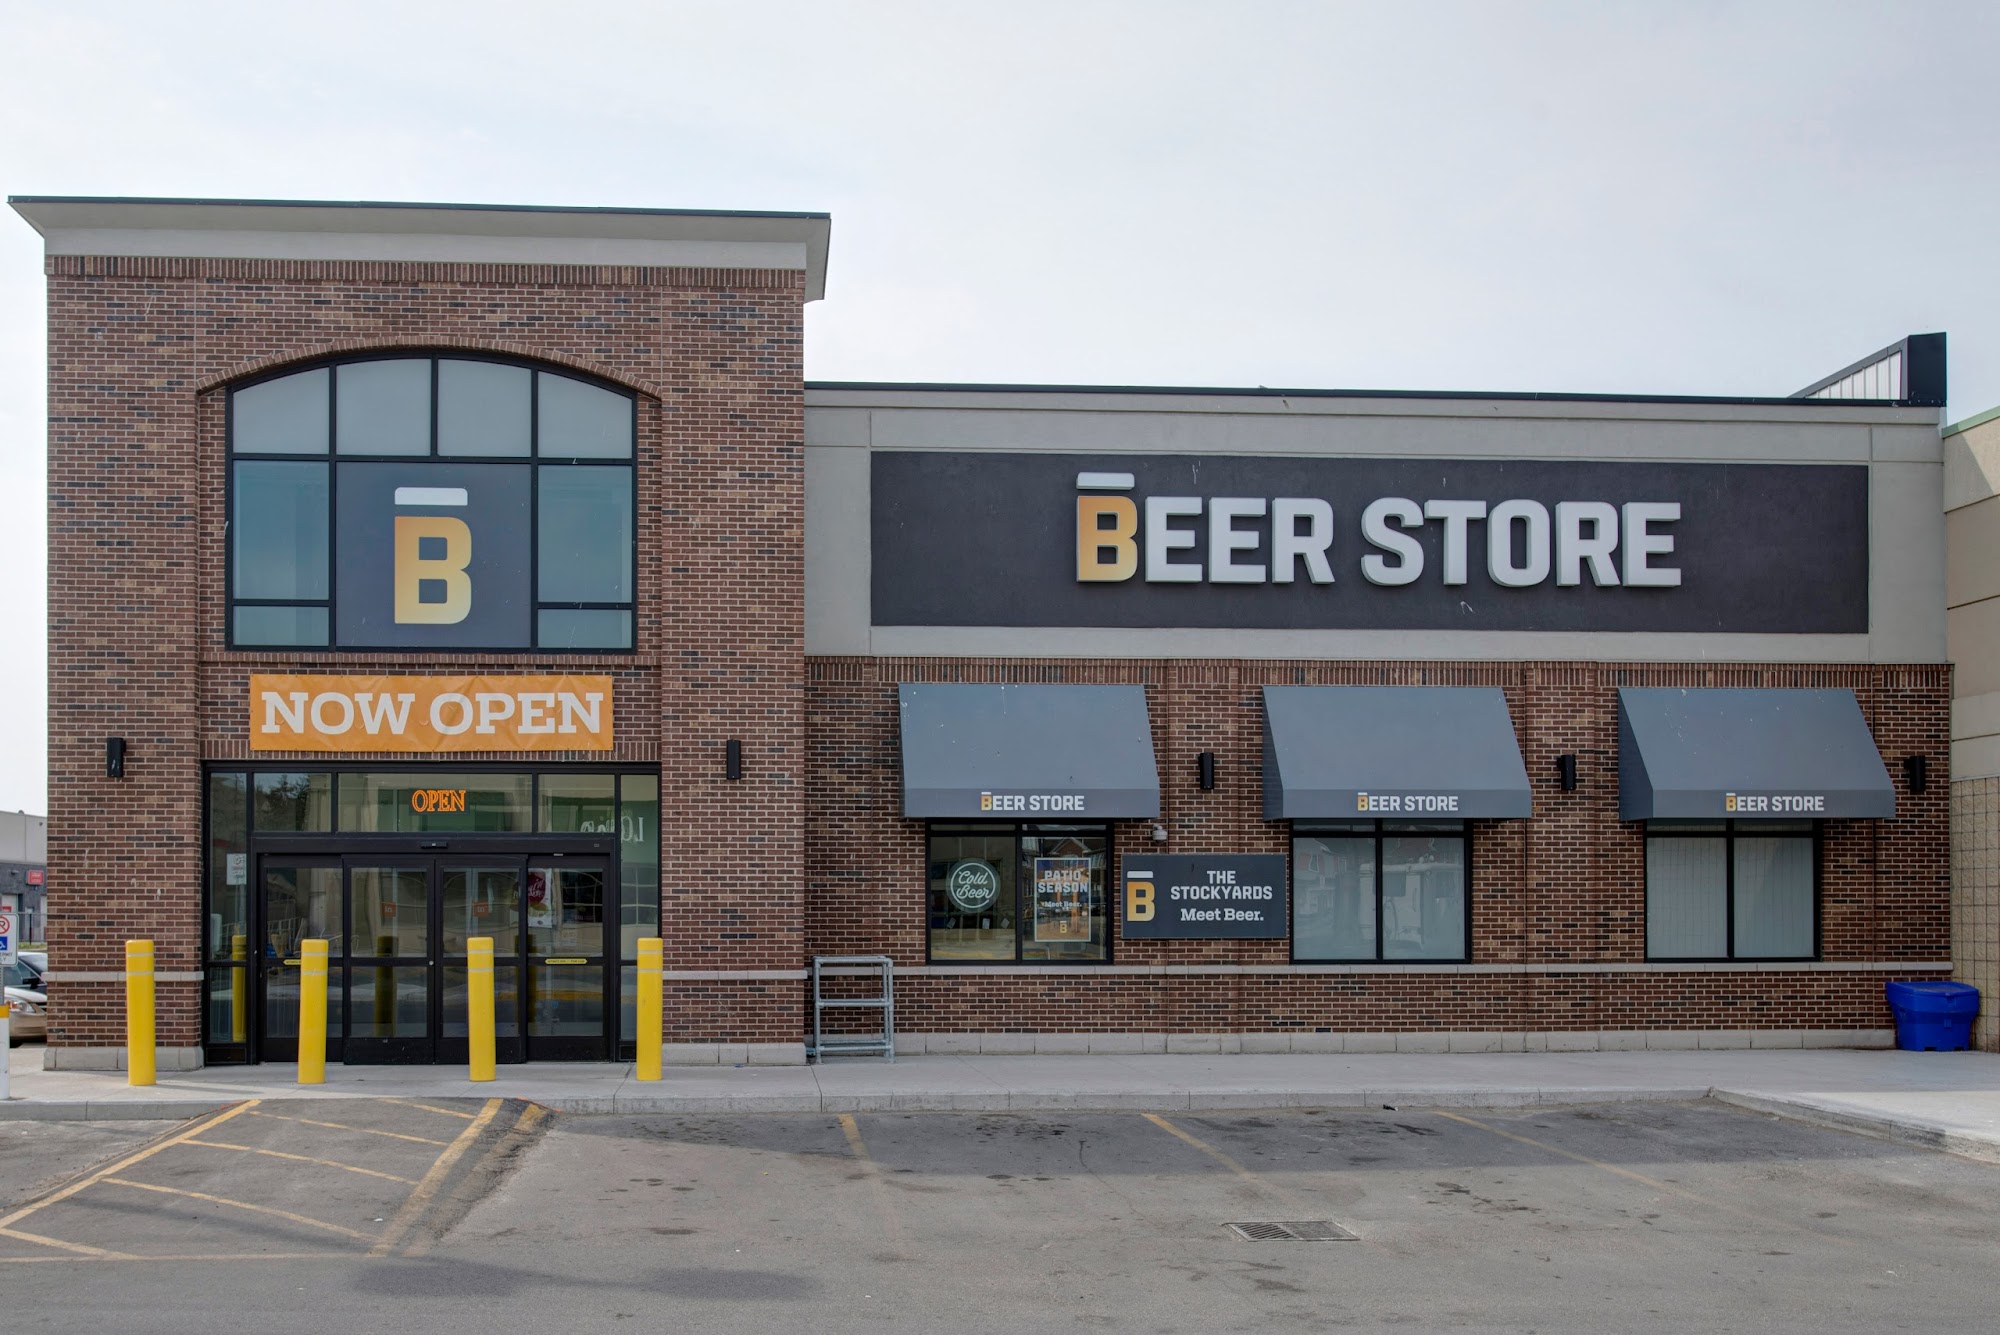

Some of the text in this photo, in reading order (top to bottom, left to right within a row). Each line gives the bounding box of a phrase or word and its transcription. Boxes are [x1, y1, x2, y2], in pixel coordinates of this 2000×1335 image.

[1076, 494, 1682, 588] BEER STORE
[394, 516, 472, 625] B
[260, 690, 604, 735] NOW OPEN
[411, 789, 467, 812] OPEN
[981, 794, 1085, 811] BEER STORE
[1357, 795, 1459, 811] BEER STORE
[1725, 795, 1825, 811] BEER STORE
[958, 870, 988, 885] Cold
[1044, 870, 1083, 881] PATIO
[1206, 870, 1236, 884] THE
[956, 885, 992, 900] Beer
[1037, 881, 1089, 894] SEASON
[1170, 885, 1273, 900] STOCKYARDS
[1126, 881, 1156, 922] B
[1180, 908, 1265, 922] Meet Beer.
